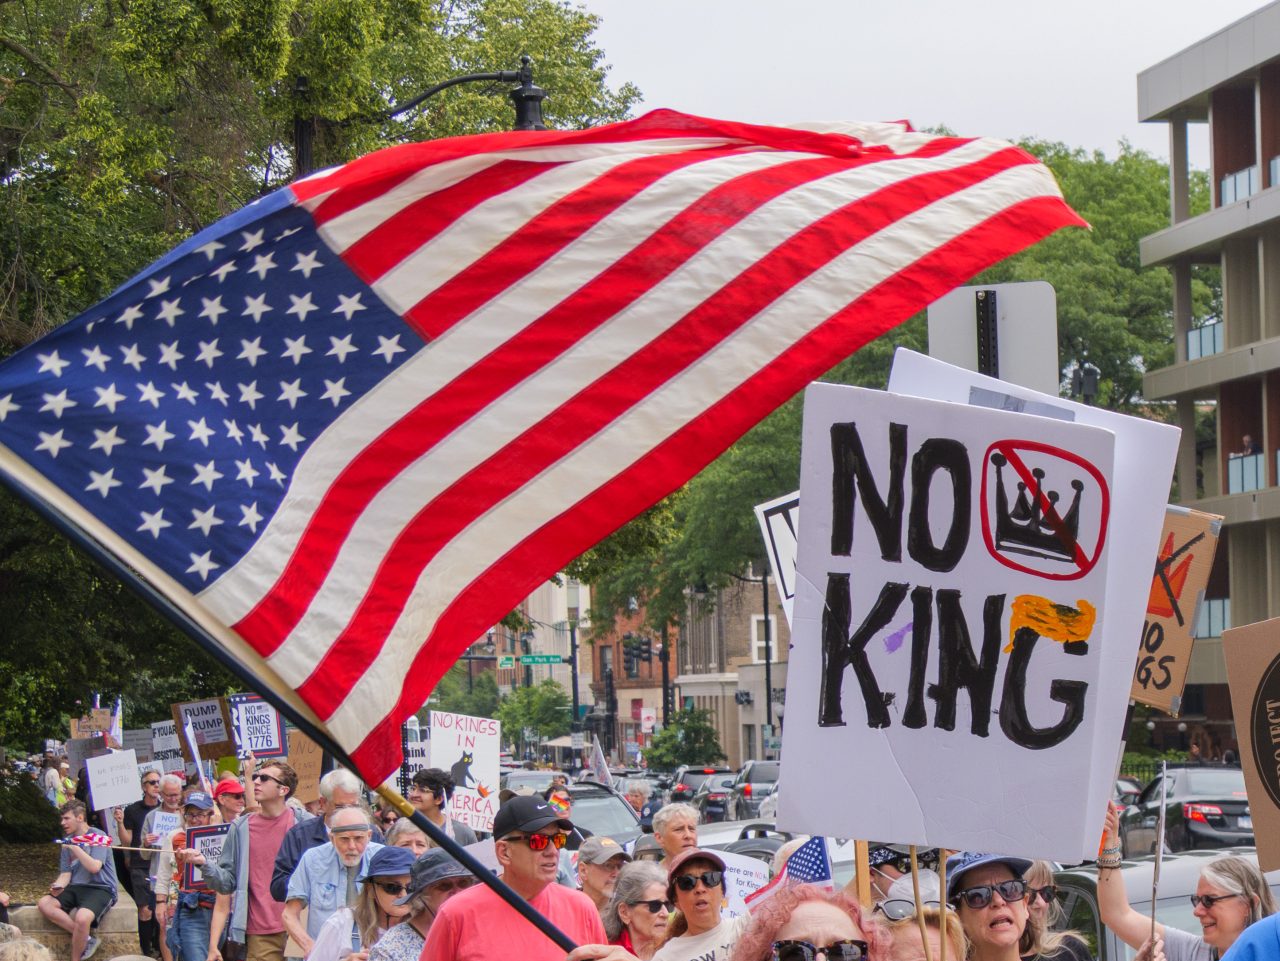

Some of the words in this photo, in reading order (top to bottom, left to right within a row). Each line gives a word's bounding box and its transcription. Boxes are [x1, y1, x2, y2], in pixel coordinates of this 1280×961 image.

[830, 421, 972, 573] NO
[818, 571, 1090, 751] KING
[184, 704, 217, 718] DUMP
[244, 705, 256, 715] NO
[187, 717, 223, 731] RUMP
[246, 714, 271, 726] KINGS
[433, 712, 453, 728] NO
[454, 717, 498, 736] KINGS
[247, 724, 272, 736] SINCE
[248, 735, 273, 748] 1776
[457, 734, 476, 748] IN
[451, 793, 494, 815] ERICA
[200, 839, 211, 848] NO
[200, 846, 222, 857] KINGS
